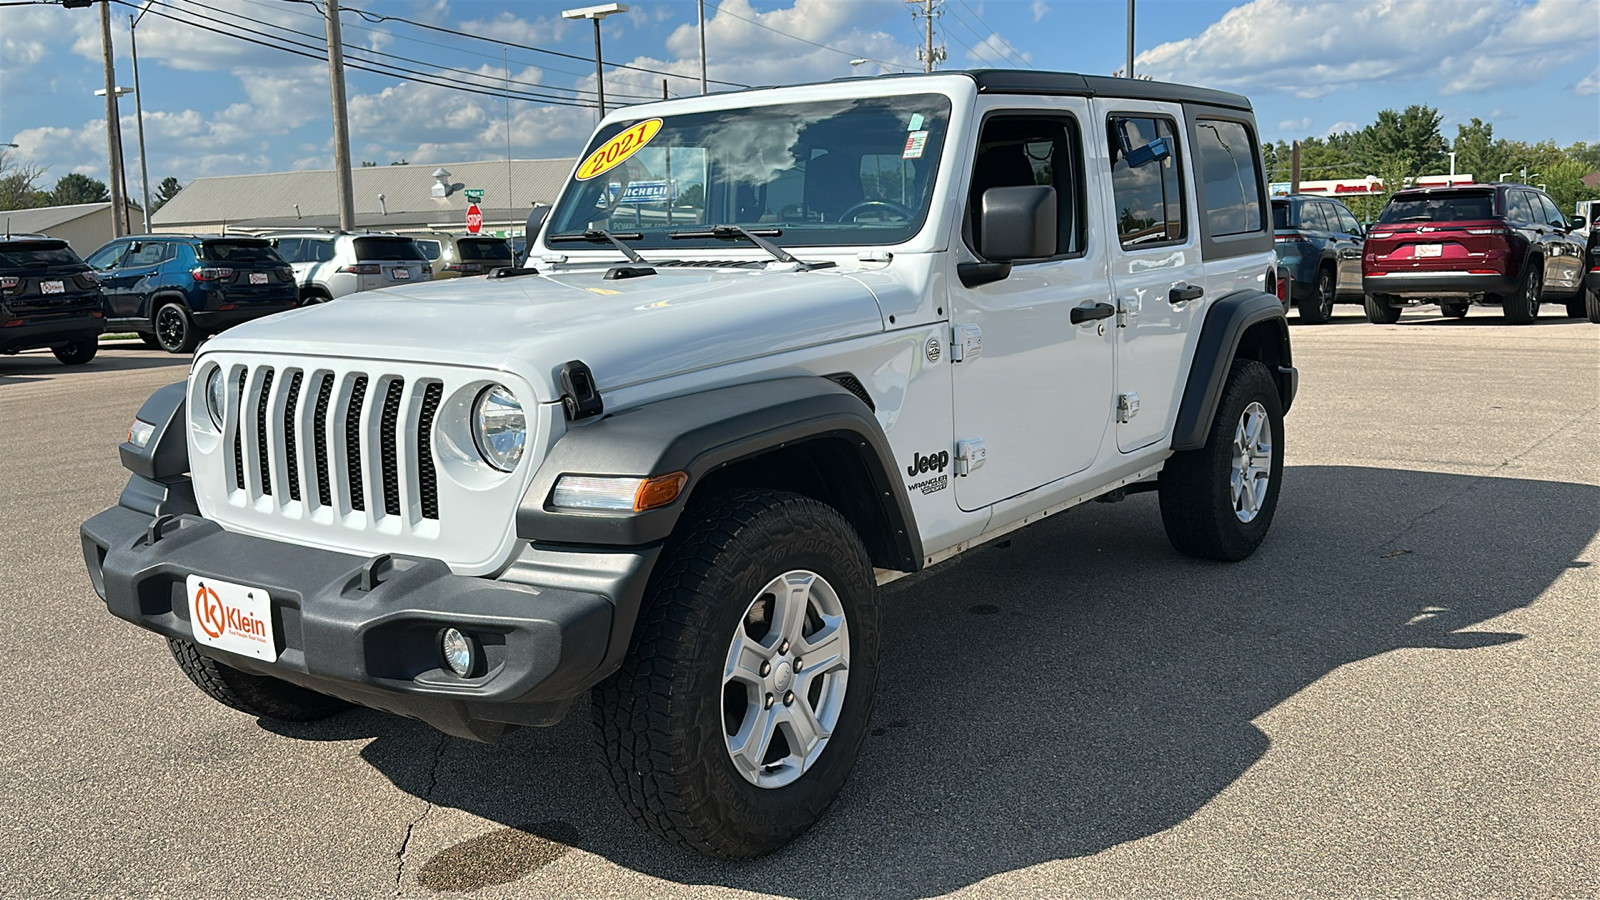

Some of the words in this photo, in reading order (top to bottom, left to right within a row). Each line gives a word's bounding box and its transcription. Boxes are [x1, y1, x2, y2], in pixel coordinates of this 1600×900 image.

[591, 124, 647, 174] 2021
[467, 214, 481, 227] STOP
[908, 450, 949, 477] Jeep
[908, 475, 947, 491] WRANGLER
[226, 606, 266, 637] Klein
